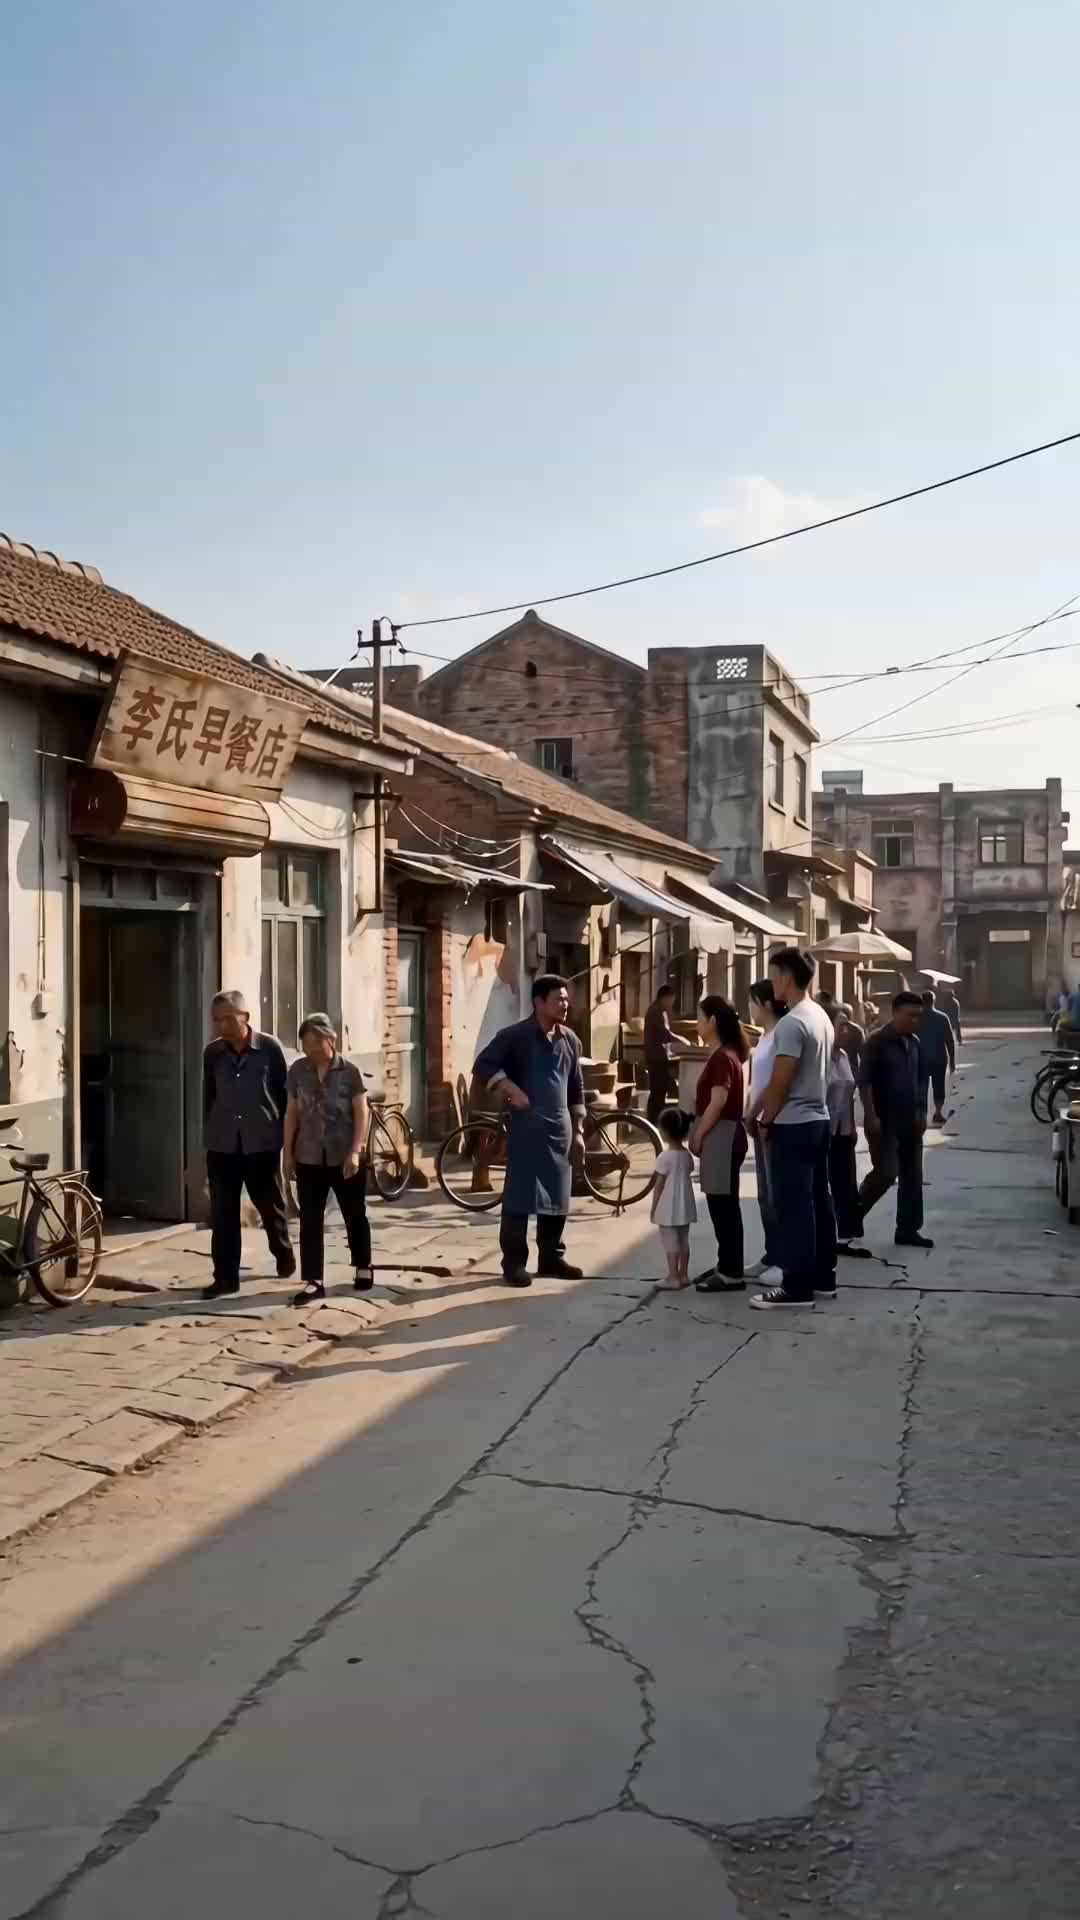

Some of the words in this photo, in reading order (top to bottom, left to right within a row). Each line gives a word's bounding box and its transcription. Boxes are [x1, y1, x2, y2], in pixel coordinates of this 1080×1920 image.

[121, 686, 288, 778] 李氏早餐店
